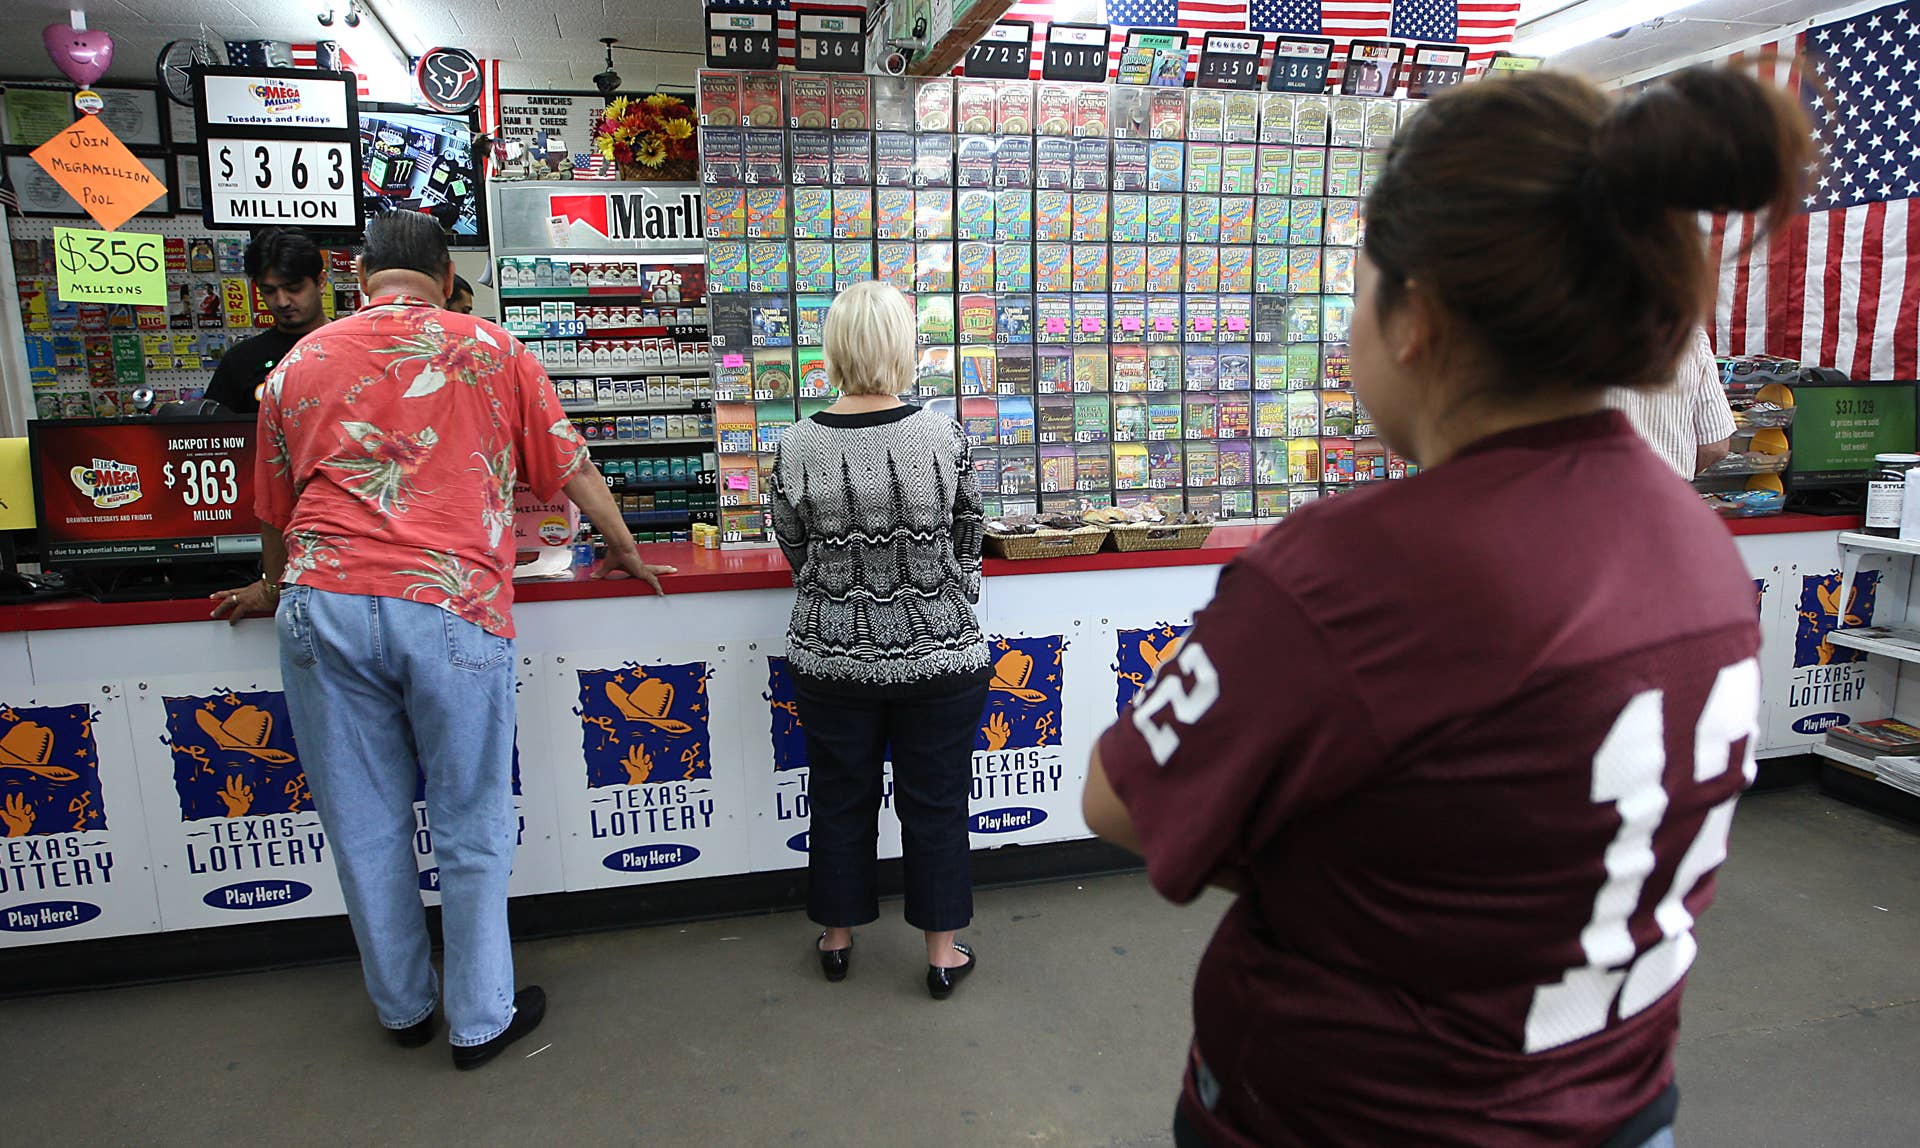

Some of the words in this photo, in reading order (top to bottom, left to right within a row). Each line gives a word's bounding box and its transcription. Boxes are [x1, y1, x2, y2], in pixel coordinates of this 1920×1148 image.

[729, 37, 770, 53] 484
[820, 40, 859, 56] 364
[265, 85, 300, 99] MEGA
[703, 83, 736, 93] CASINO
[795, 86, 826, 97] CASINO
[834, 86, 866, 97] CASINO
[264, 98, 301, 107] MILLIONS
[527, 96, 573, 106] SANWICHES
[1078, 98, 1107, 108] CASINO
[502, 106, 539, 116] CHICKEN
[541, 107, 567, 116] SALAD
[226, 115, 272, 124] Tuesdays
[275, 115, 293, 123] and
[295, 116, 331, 125] Fridays
[503, 117, 520, 125] HAM
[539, 117, 568, 126] CHEESE
[1075, 128, 1085, 137] 10
[1152, 129, 1161, 138] 12
[1225, 132, 1234, 140] 14
[67, 130, 109, 149] JOIN
[51, 157, 150, 184] MEGAMILLION
[877, 175, 889, 184] 27
[1073, 179, 1084, 188] 32
[1188, 183, 1198, 192] 35
[82, 186, 115, 205] POOL
[230, 199, 338, 218] MILLION
[707, 228, 719, 237] 45
[748, 228, 760, 237] 46
[834, 228, 846, 237] 48
[1037, 231, 1048, 240] 53
[1188, 232, 1197, 241] 57
[59, 232, 159, 275] $356
[71, 283, 143, 295] MILLIONS
[710, 283, 722, 292] 67
[750, 282, 762, 291] 68
[917, 282, 928, 291] 72
[1038, 282, 1048, 291] 75
[140, 316, 161, 325] BIG
[258, 314, 275, 324] RED
[558, 322, 585, 336] 5.99
[753, 337, 765, 345] 90
[798, 336, 809, 344] 91
[919, 335, 930, 344] 94
[960, 334, 972, 343] 95
[1038, 333, 1048, 342] 97
[1186, 333, 1200, 341] 101
[962, 385, 978, 394] 117
[1115, 382, 1129, 391] 121
[1220, 380, 1233, 389] 124
[755, 390, 772, 399] 112
[801, 388, 817, 397] 113
[1835, 400, 1875, 416] $37,129
[1867, 418, 1880, 426] sold
[1257, 428, 1271, 437] 147
[1324, 426, 1337, 435] 149
[1835, 431, 1842, 439] at
[1842, 430, 1852, 439] this
[1852, 430, 1875, 439] location
[167, 438, 209, 451] JACKPOT
[210, 438, 221, 449] IS
[223, 437, 246, 449] NOW
[1840, 442, 1851, 451] last
[93, 458, 111, 470] TEXAS
[96, 469, 138, 486] MEGA
[93, 484, 139, 498] MILLIONS
[721, 496, 738, 505] 155
[66, 515, 94, 524] DRAWINGS
[94, 514, 119, 523] TUESDAYS
[119, 514, 131, 522] AND
[131, 513, 153, 521] FRIDAYS
[193, 509, 232, 521] MILLION
[54, 547, 67, 555] due
[67, 547, 76, 555] to
[82, 545, 113, 556] potential
[113, 544, 138, 554] battery
[139, 544, 156, 552] issue
[180, 542, 200, 550] Texas
[1806, 666, 1852, 685] TEXAS
[1789, 677, 1865, 708] LOTTERY
[1803, 719, 1819, 732] Play
[1819, 715, 1840, 729] Here!
[973, 750, 1040, 773] TEXAS
[970, 764, 1063, 800] OTTERY
[612, 784, 688, 810] TEXAS
[590, 798, 715, 839] LOTTERY
[978, 813, 1002, 831] Play
[1001, 809, 1031, 827] Here!
[209, 817, 295, 844] TEXAS
[0, 836, 81, 866] EXAS
[186, 832, 326, 875] LOTTERY
[1523, 656, 1760, 1056] 12
[622, 852, 649, 868] Play
[649, 848, 682, 865] Here!
[0, 851, 114, 894] OTTERY
[225, 887, 256, 906] Play
[257, 885, 293, 903] Here!
[8, 911, 41, 928] Play
[42, 908, 80, 925] Here!
